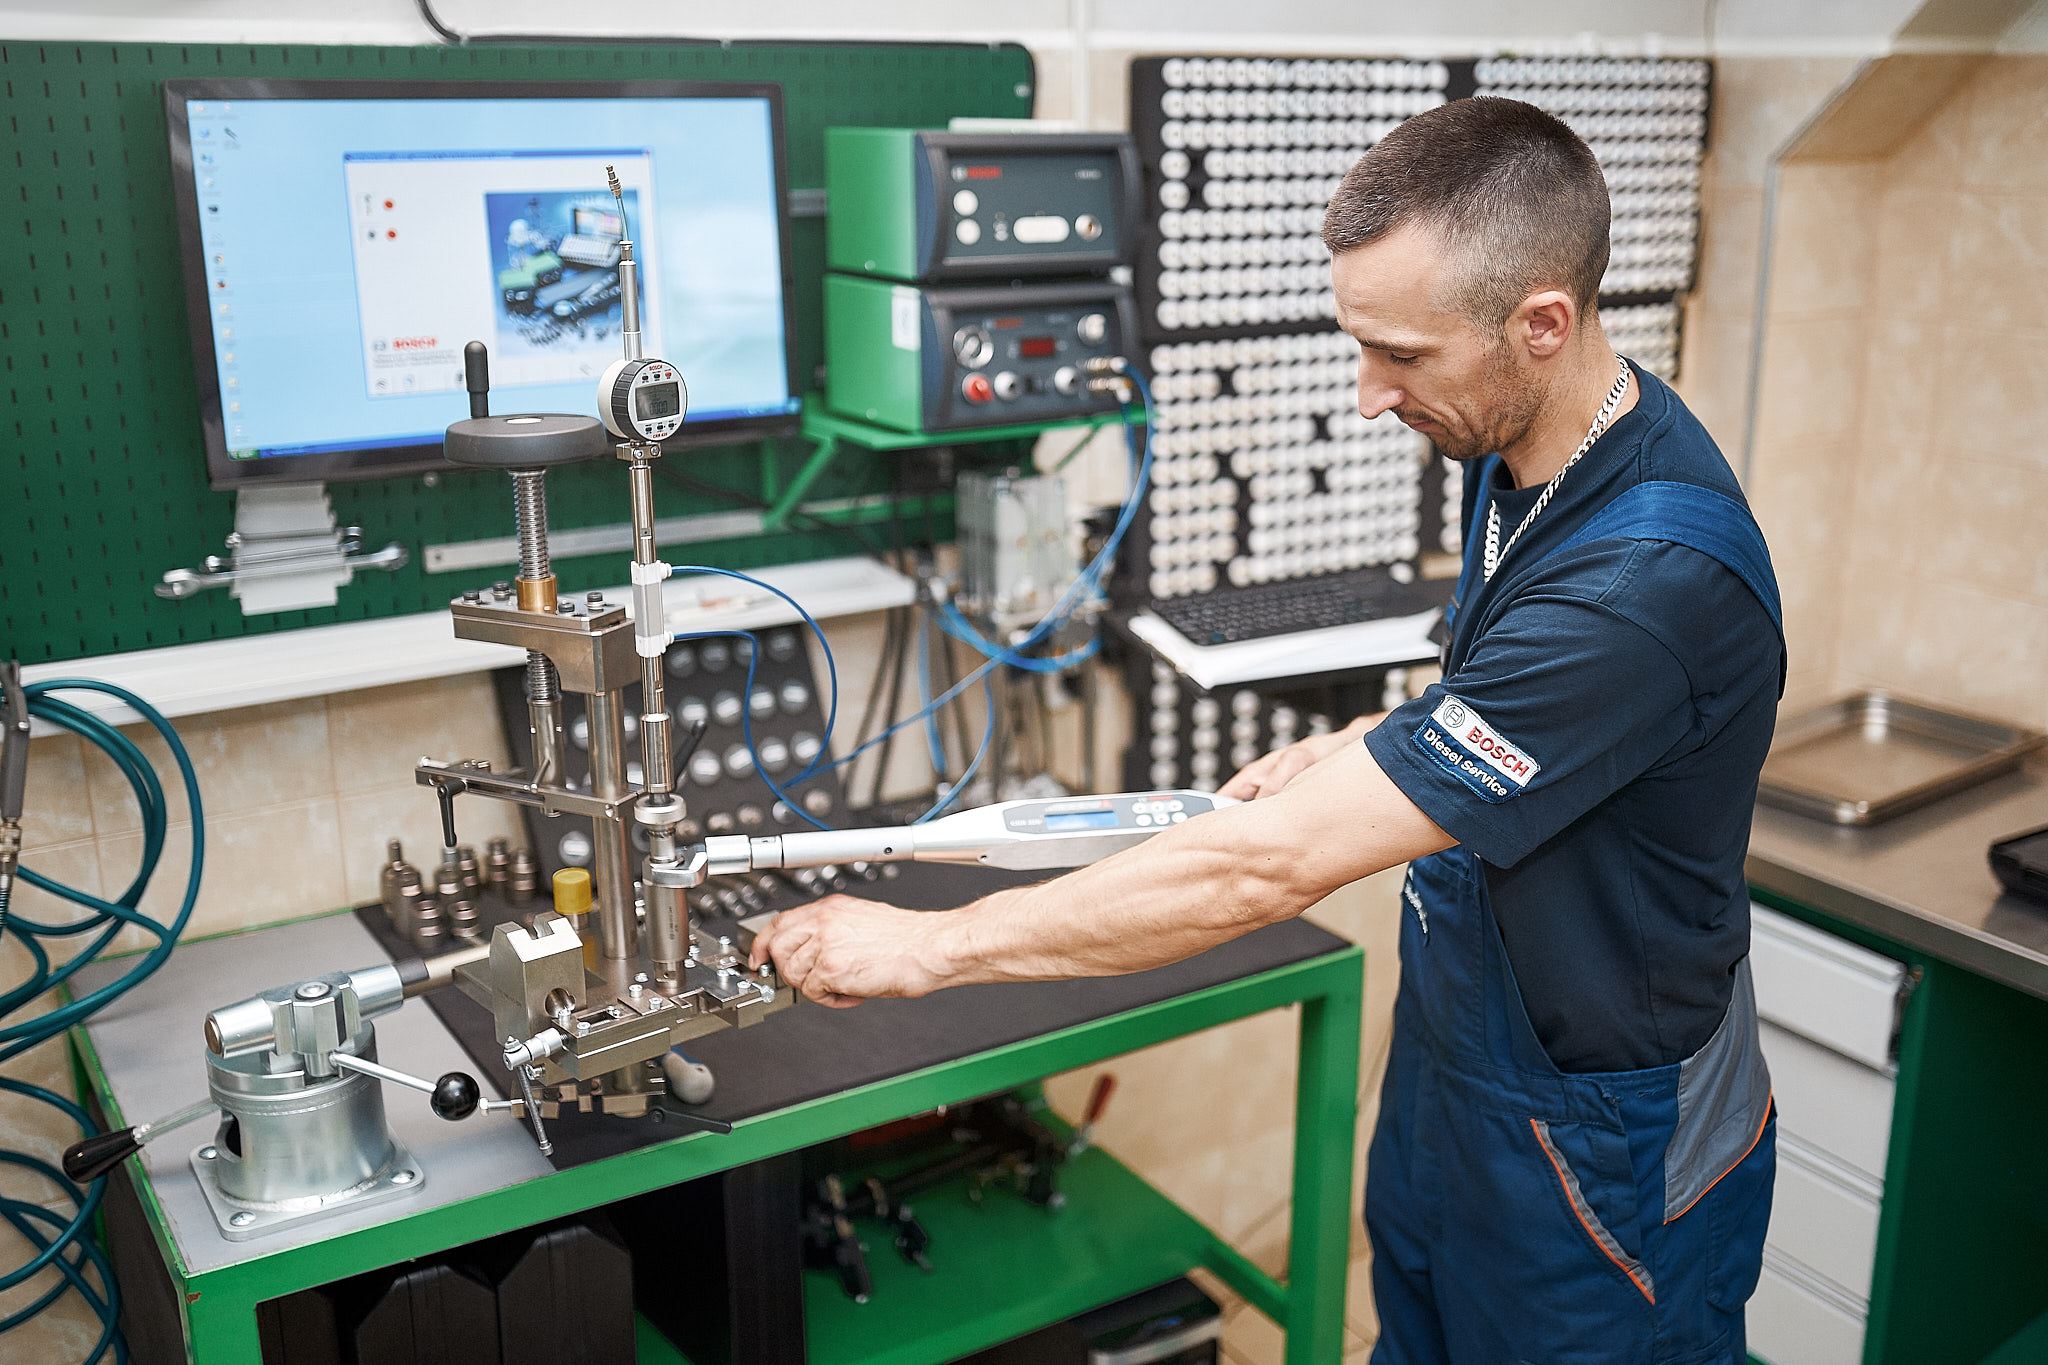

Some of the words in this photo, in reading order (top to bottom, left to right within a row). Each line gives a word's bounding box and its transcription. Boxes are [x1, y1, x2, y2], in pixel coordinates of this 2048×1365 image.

[1423, 726, 1464, 767] Diesel
[1460, 760, 1508, 797] Service
[1466, 725, 1529, 778] BOSCH
